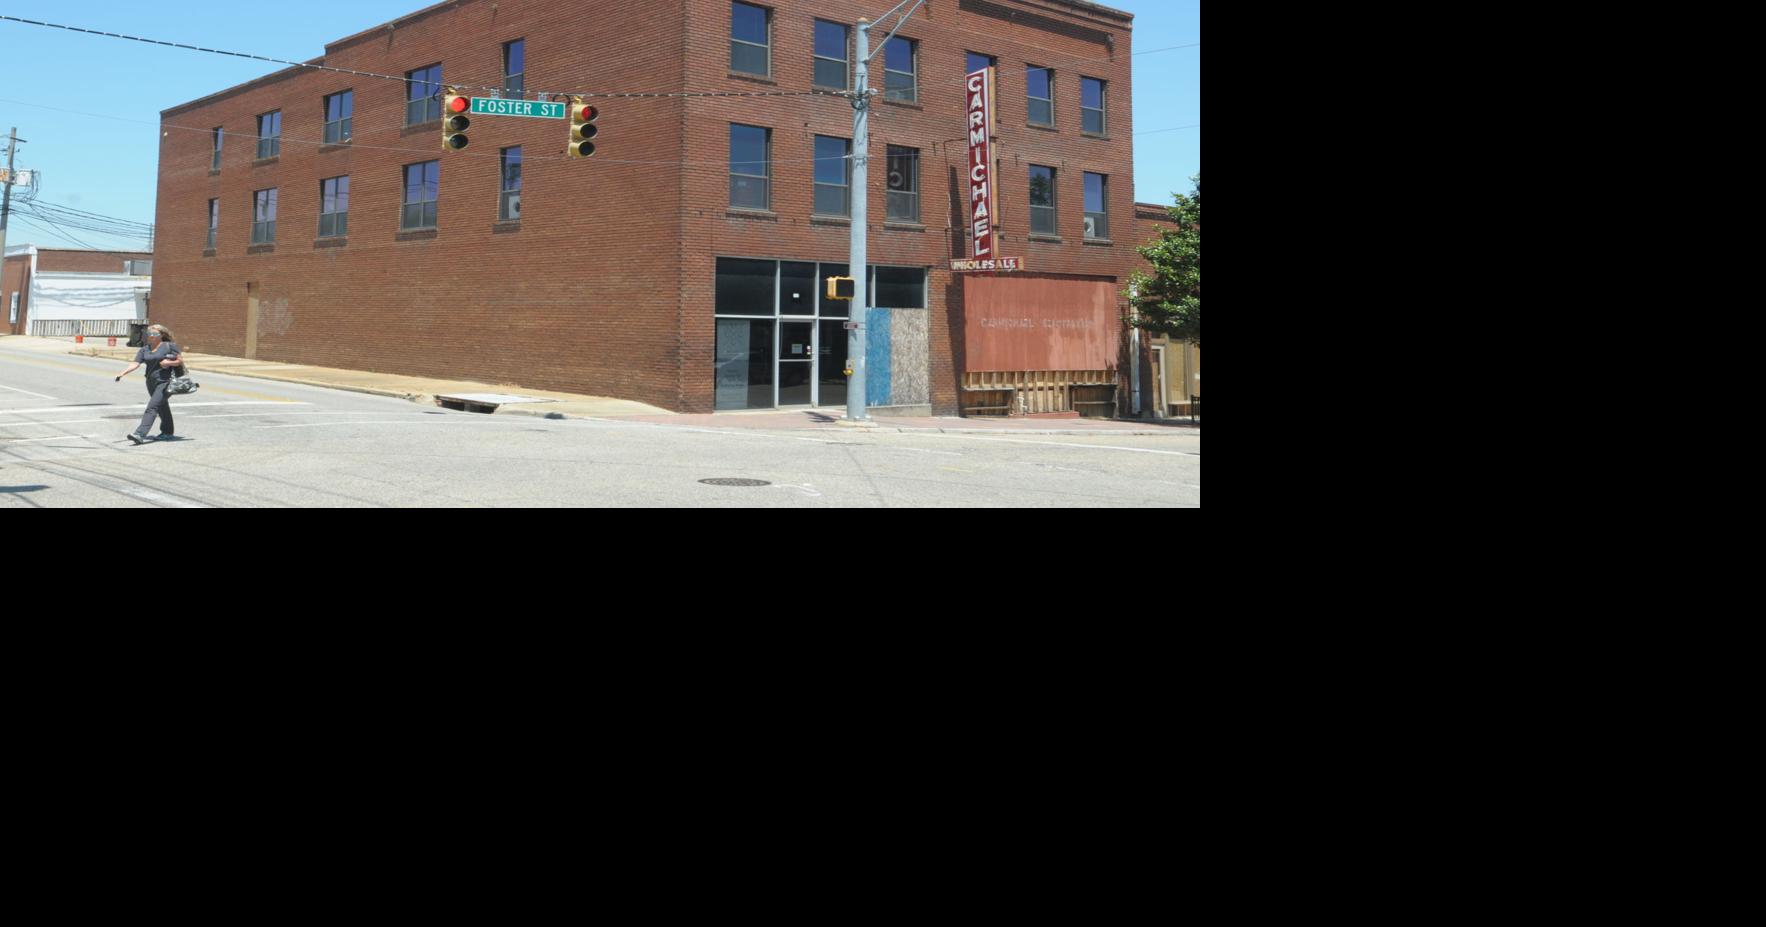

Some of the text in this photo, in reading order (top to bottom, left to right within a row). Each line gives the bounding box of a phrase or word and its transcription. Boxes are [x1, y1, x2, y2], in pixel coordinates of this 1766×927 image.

[478, 100, 558, 116] FOSTER ST
[967, 75, 990, 257] CARMICHAEL
[951, 259, 1017, 270] WHOLESALE
